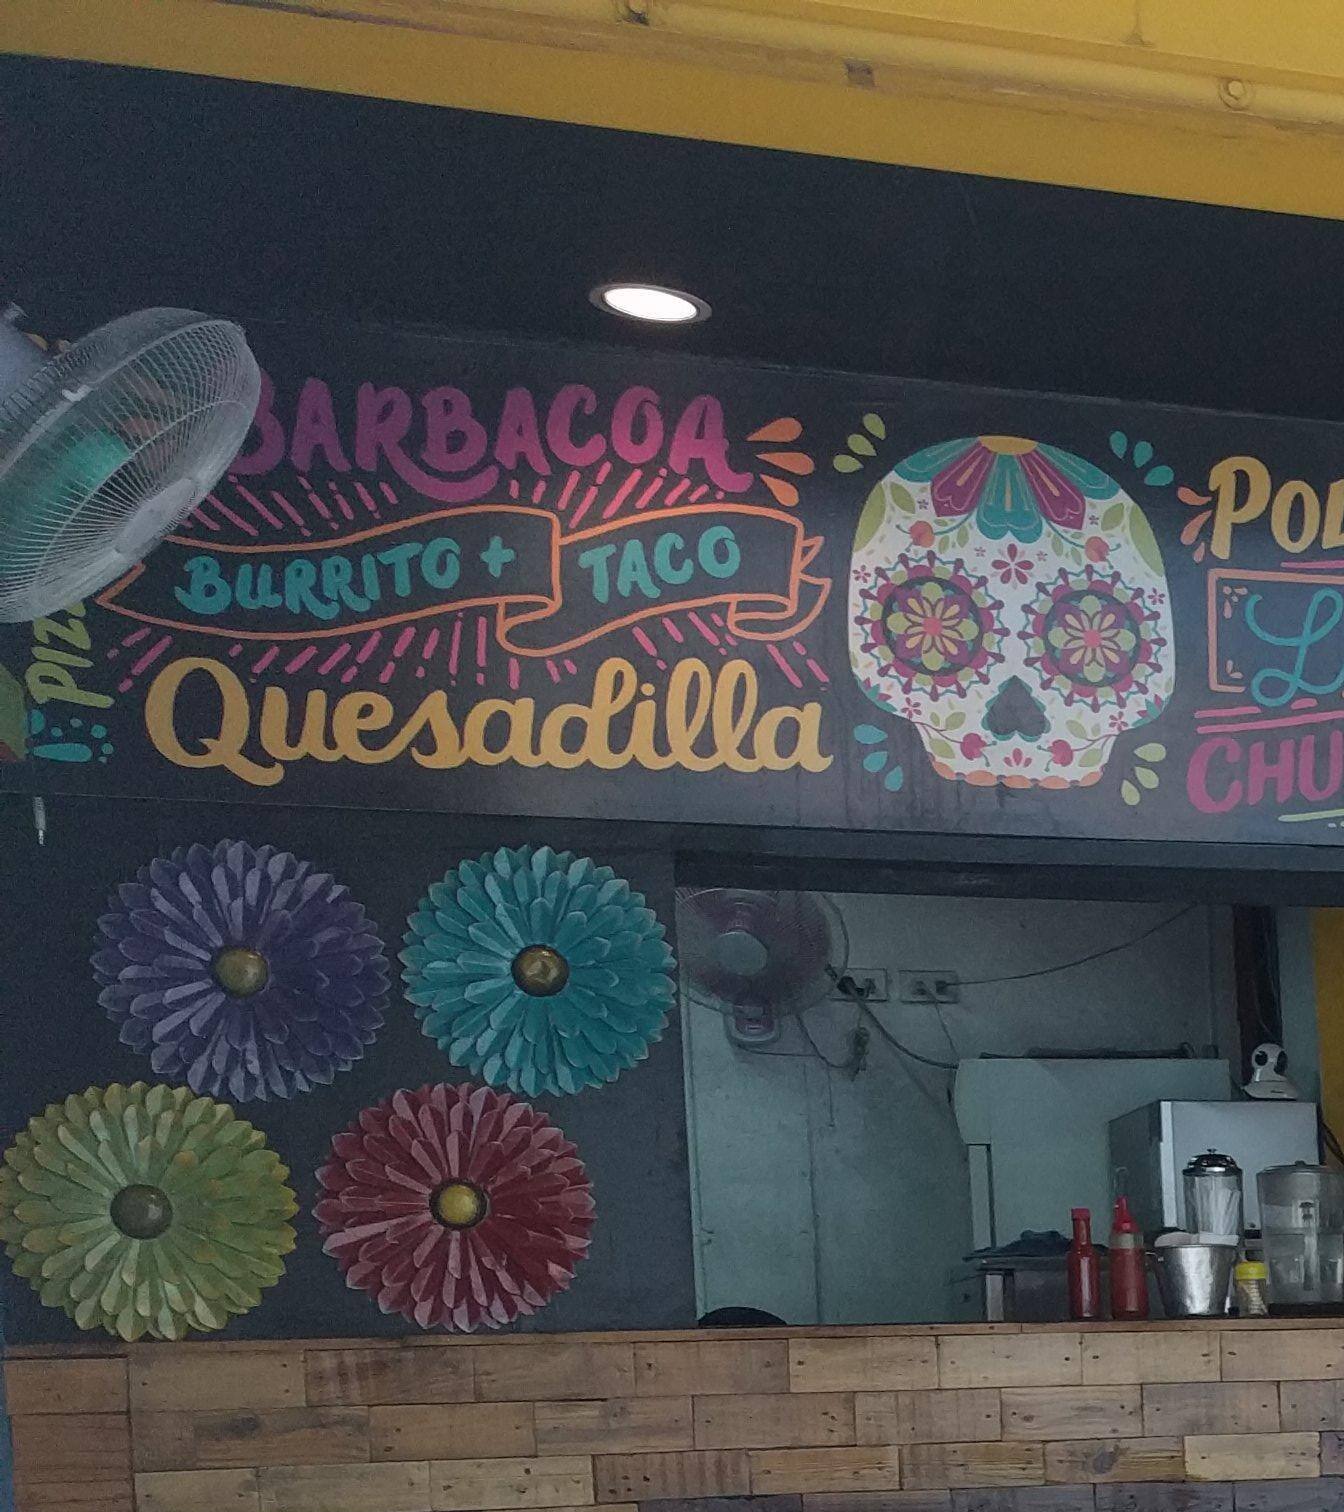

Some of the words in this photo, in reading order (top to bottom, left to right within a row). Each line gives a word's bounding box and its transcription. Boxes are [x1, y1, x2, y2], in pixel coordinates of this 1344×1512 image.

[174, 536, 462, 620] BURRITO
[580, 525, 741, 604] TACO
[144, 655, 834, 787] Quesadilla
